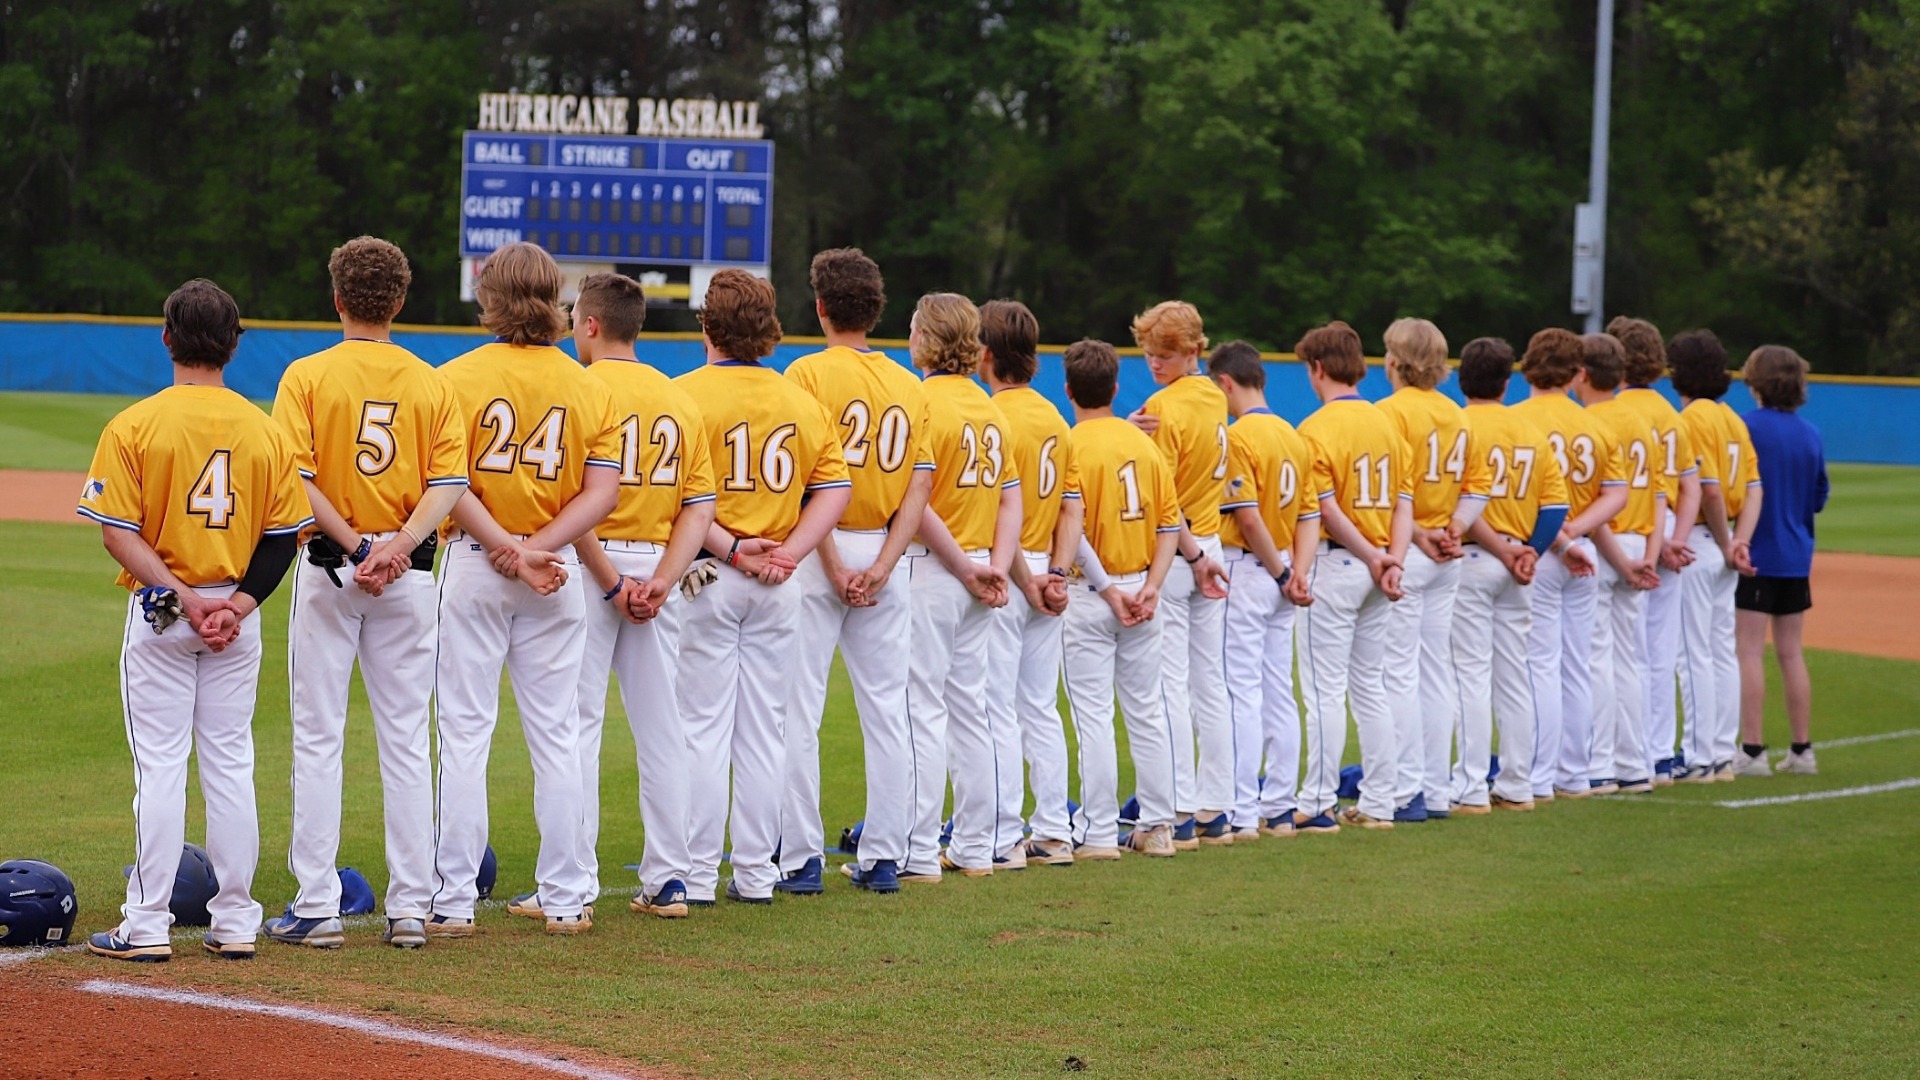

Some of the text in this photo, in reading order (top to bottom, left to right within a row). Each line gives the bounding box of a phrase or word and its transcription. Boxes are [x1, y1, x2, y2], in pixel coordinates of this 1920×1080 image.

[478, 92, 765, 138] HURRICANE BASEBALL
[474, 142, 526, 164] BALL
[561, 144, 630, 168] STRIKE
[686, 148, 733, 170] OUT
[464, 195, 525, 218] GUEST
[531, 180, 704, 203] 1 2 3 4 5 6 7 8 9
[715, 186, 764, 205] TOTAL
[466, 227, 522, 249] WREN
[356, 400, 398, 477] 5
[475, 397, 566, 482] 24
[620, 414, 680, 486] 12
[725, 421, 796, 494] 16
[840, 399, 911, 473] 20
[956, 422, 1003, 488] 23
[1423, 428, 1468, 483] 14
[1549, 431, 1595, 484] 33
[1652, 427, 1679, 477] 1
[187, 450, 235, 529] 4
[1038, 435, 1057, 499] 6
[1117, 460, 1145, 521] 1
[1279, 458, 1298, 511] 9
[1353, 452, 1392, 510] 11
[1488, 444, 1536, 499] 27
[1727, 441, 1741, 490] 7
